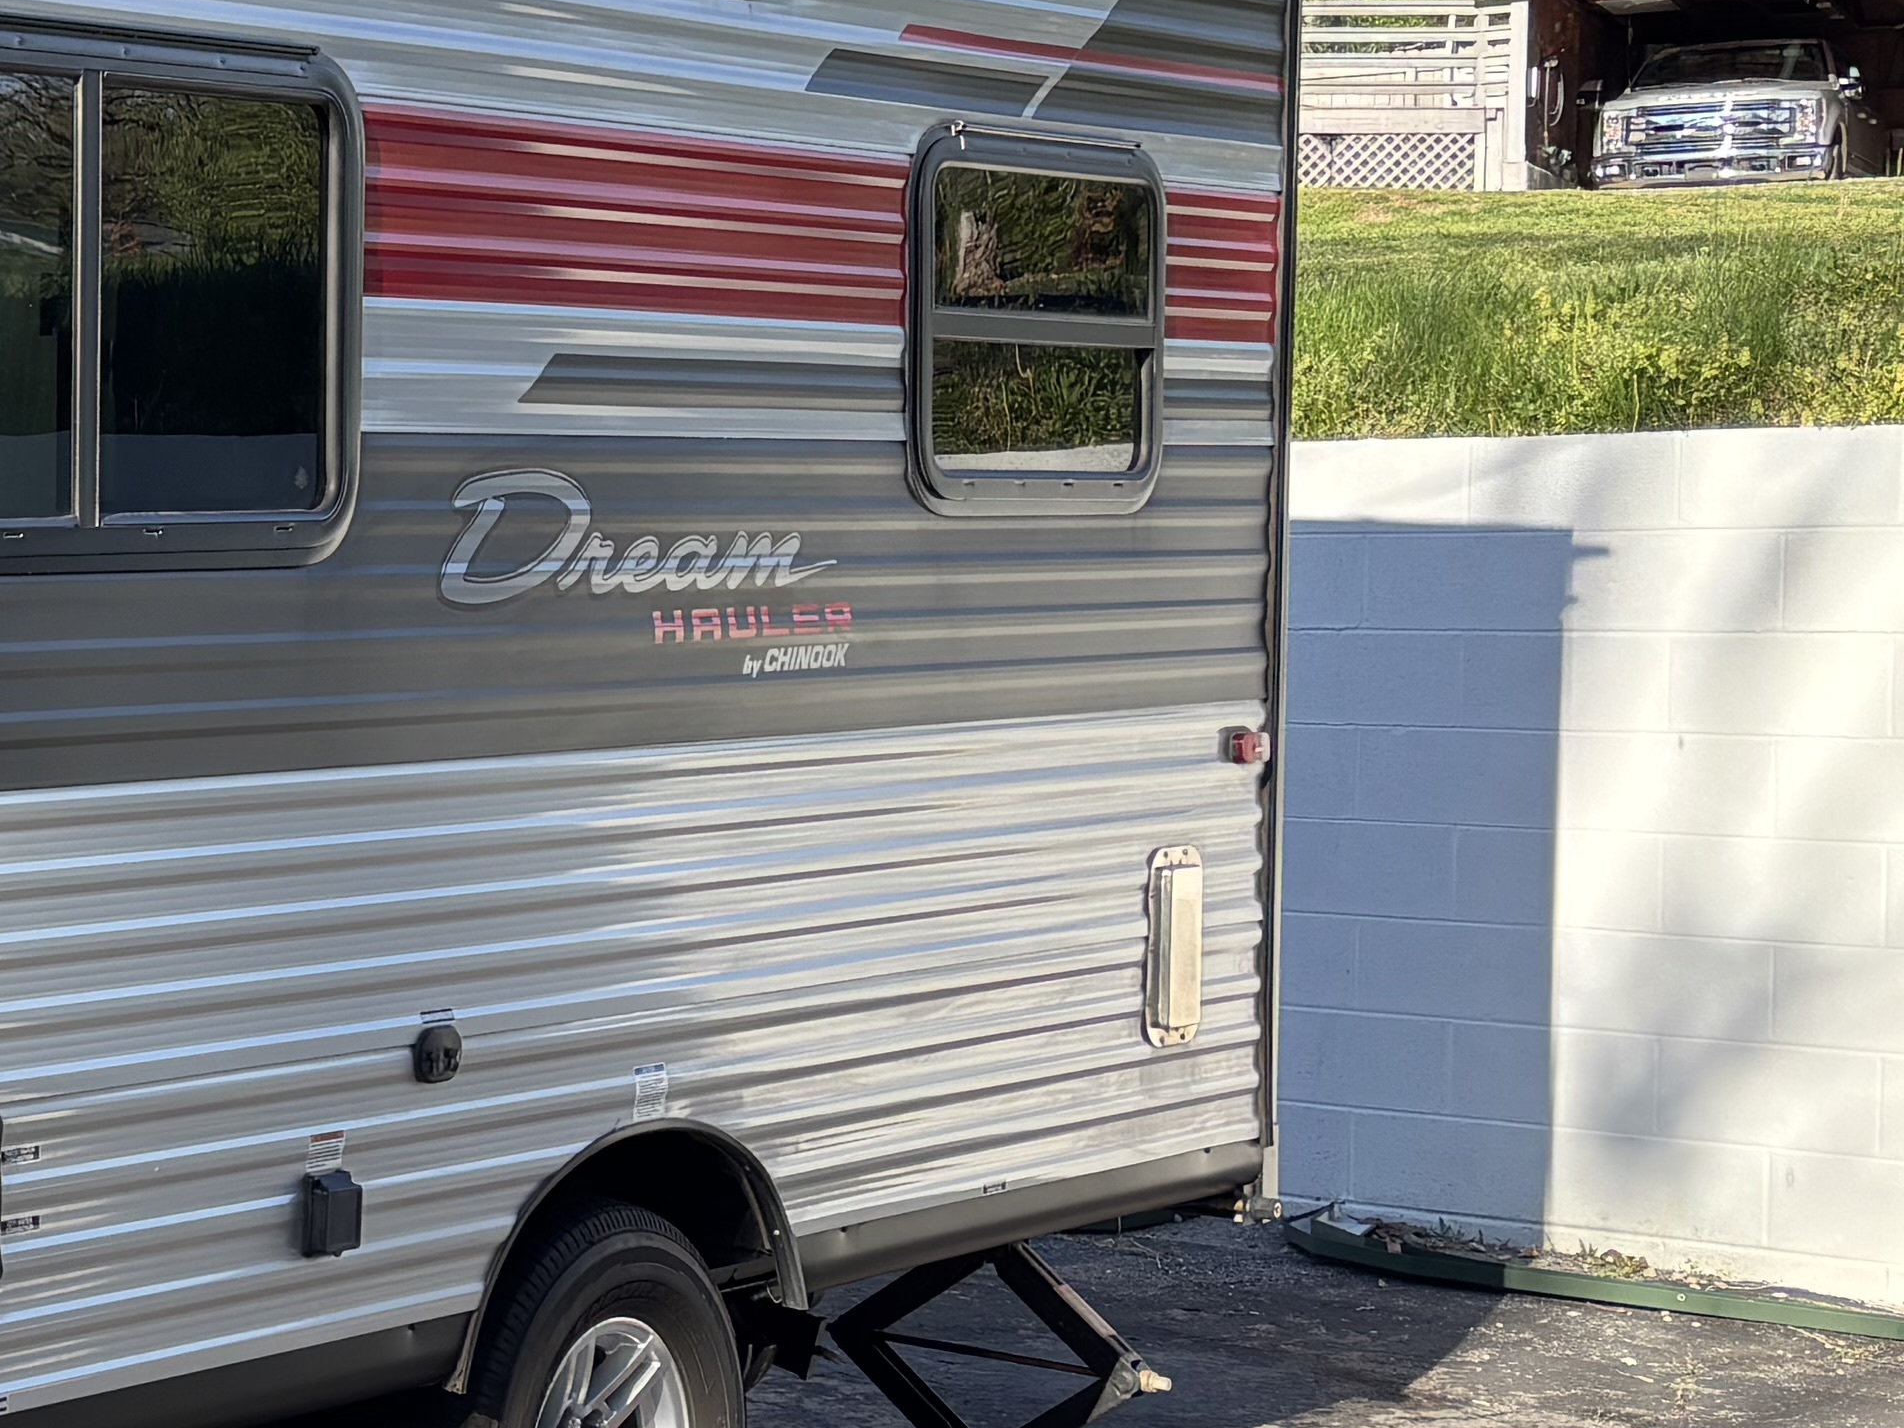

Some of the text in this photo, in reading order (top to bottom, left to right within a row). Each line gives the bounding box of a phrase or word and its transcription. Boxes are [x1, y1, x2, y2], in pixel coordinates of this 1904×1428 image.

[439, 467, 838, 605] Dream
[651, 602, 854, 644] HAULER
[742, 643, 850, 678] by CHINOOK
